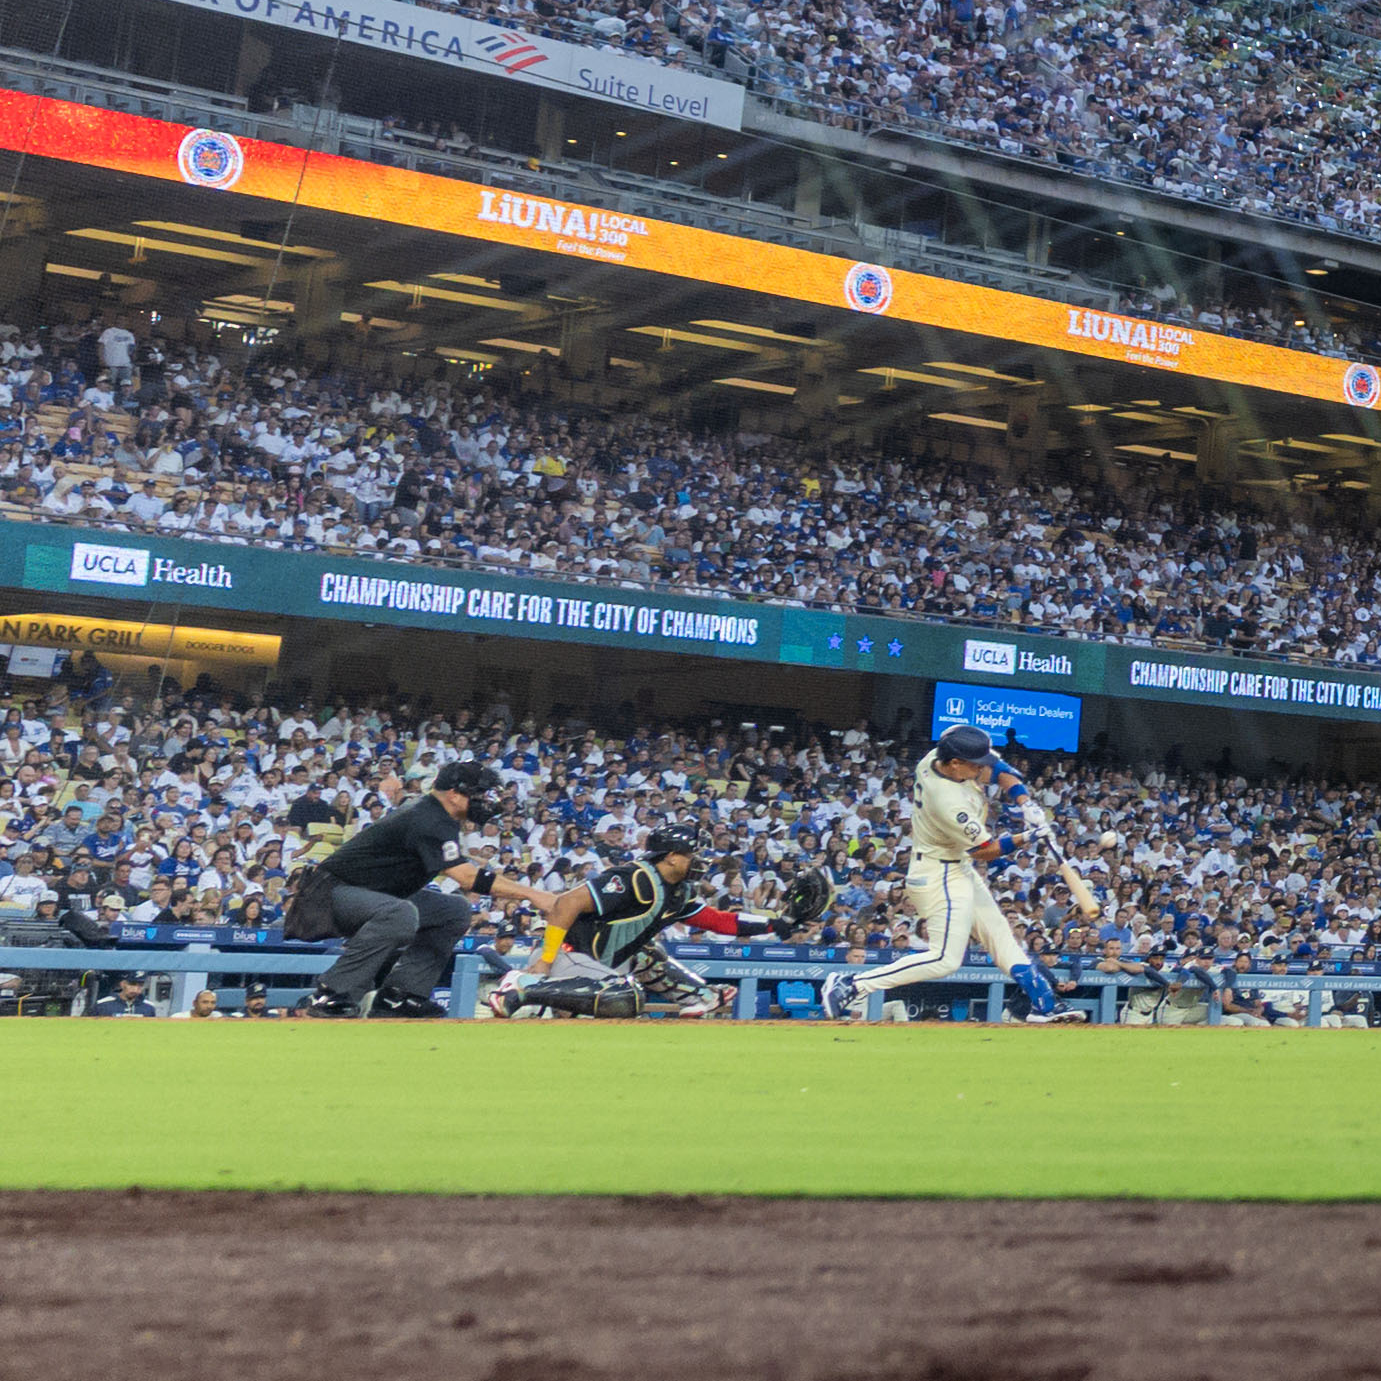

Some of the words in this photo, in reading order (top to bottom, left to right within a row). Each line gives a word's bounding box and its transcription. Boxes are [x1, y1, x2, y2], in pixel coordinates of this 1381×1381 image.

[293, 0, 464, 62] AMERICA
[579, 68, 640, 102] Suite
[647, 84, 708, 118] Level
[477, 191, 597, 240] LiUNA!
[600, 214, 649, 236] LOCAL
[598, 228, 629, 247] 300
[1066, 309, 1157, 351] LiUNA!
[1158, 325, 1195, 346] LOCAL
[1157, 340, 1181, 356] 300
[83, 553, 137, 575] UCLA
[152, 558, 233, 589] Health
[320, 572, 466, 615] CHAMPIONSHIP
[467, 588, 516, 621] CARE
[517, 593, 553, 624] FOR
[556, 597, 592, 628] THE
[593, 602, 636, 632] CITY
[636, 606, 660, 635] OF
[661, 609, 759, 645] CHAMPIONS
[28, 622, 83, 644] PARK
[972, 648, 1009, 666] UCLA
[1018, 650, 1072, 676] Health
[1130, 660, 1228, 694] CHAMPIONSHIP
[1229, 671, 1263, 697] CARE
[1264, 675, 1288, 700] FOR
[1291, 678, 1315, 704] THE
[1316, 681, 1345, 707] CITY
[1346, 685, 1362, 708] OF
[977, 699, 1004, 713] SoCal
[1006, 702, 1037, 717] Honda
[1038, 706, 1074, 720] Dealers
[121, 927, 146, 939] blue
[233, 930, 257, 941] blue
[723, 946, 742, 957] blue
[808, 948, 827, 957] blue
[725, 968, 749, 976] BANK
[751, 968, 761, 976] OF
[765, 969, 805, 977] AMERICA
[1082, 976, 1117, 985] AMERICA
[1237, 980, 1257, 988] BANK
[1268, 981, 1299, 989] AMERICA
